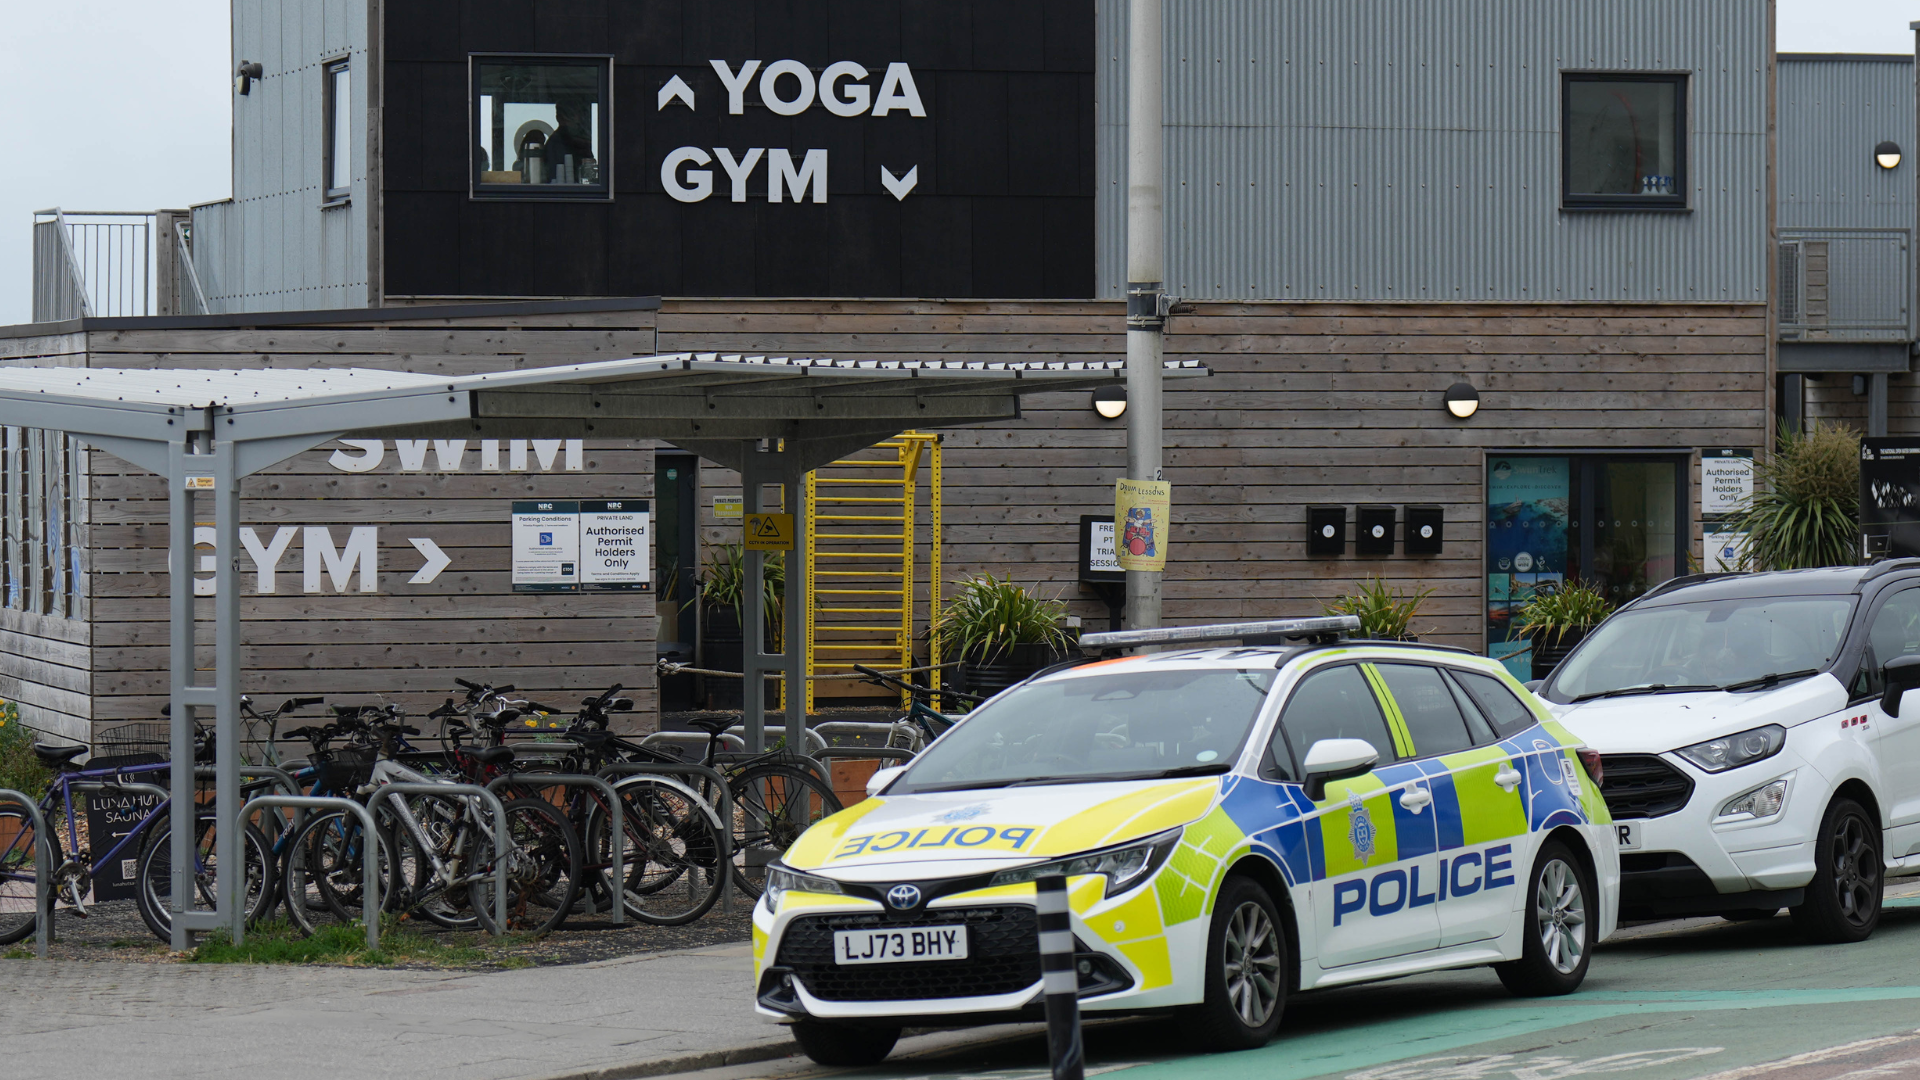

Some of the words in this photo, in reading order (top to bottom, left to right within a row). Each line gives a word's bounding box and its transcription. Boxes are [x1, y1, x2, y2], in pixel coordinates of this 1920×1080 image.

[708, 59, 927, 117] YOGA
[660, 146, 828, 204] GYM
[1706, 468, 1750, 476] Authorised
[1719, 494, 1738, 502] Only
[586, 526, 645, 536] Authorised
[1098, 524, 1115, 532] FRE
[598, 537, 633, 546] Permit
[1103, 536, 1114, 544] PT
[595, 547, 636, 557] Holders
[1096, 547, 1116, 556] TRIA
[604, 558, 629, 570] Only
[1332, 843, 1515, 928] POLICE
[844, 933, 905, 960] LJ73
[911, 930, 956, 956] BHY
